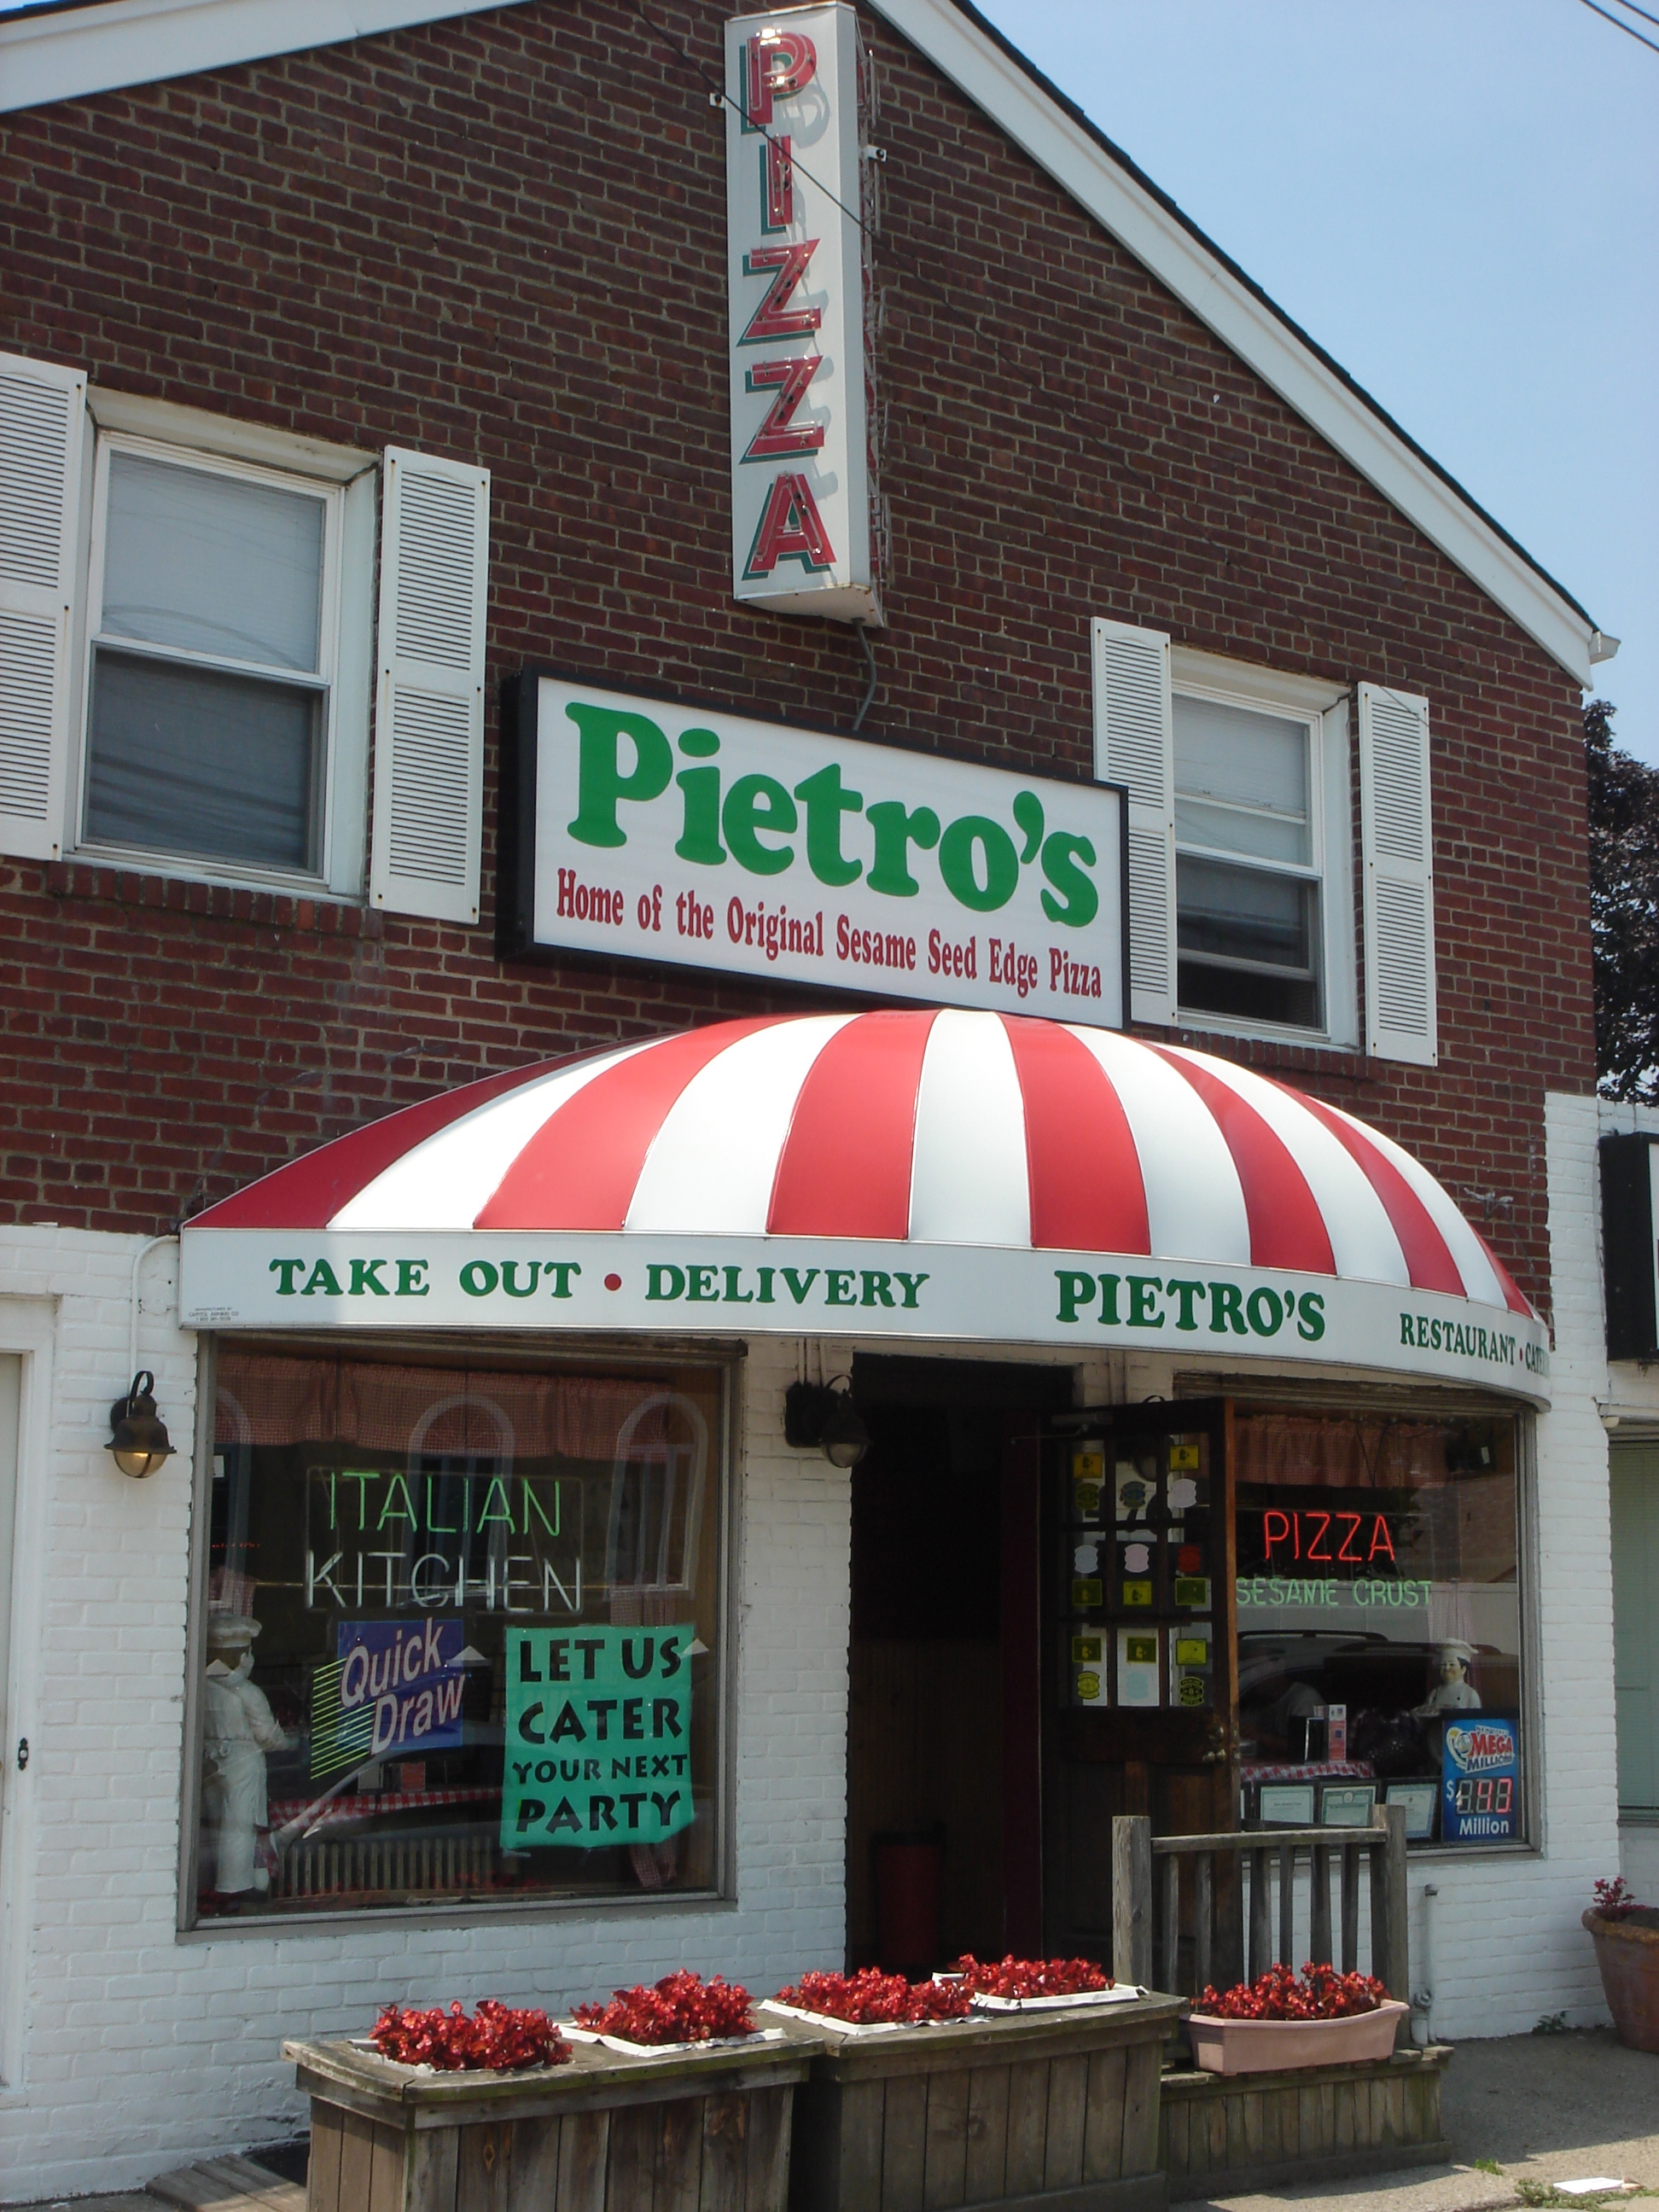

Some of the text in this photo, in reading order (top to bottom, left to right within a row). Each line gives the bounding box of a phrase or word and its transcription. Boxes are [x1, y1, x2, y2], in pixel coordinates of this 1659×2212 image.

[740, 32, 836, 579] PIZZA
[565, 701, 1098, 928] Pietro's
[556, 868, 1102, 998] Home of the Original Sesame Seed Edge Pizza
[268, 1258, 930, 1308] TAKE OUT DELIVERY
[1055, 1271, 1325, 1342] PIETRO'S
[1400, 1313, 1516, 1366] RESTAURANT
[328, 1470, 562, 1536] ITALIAN
[1264, 1511, 1396, 1562] PIZZA
[306, 1549, 581, 1614] KITCHEN
[1236, 1577, 1433, 1607] SESAME CRUST
[341, 1616, 444, 1708] Quick
[519, 1637, 681, 1683] LET US
[370, 1674, 466, 1756] Draw
[517, 1697, 684, 1743] CATER
[512, 1754, 688, 1784] YOUR NEXT
[1468, 1732, 1512, 1757] MEGA
[515, 1790, 682, 1833] PARTY
[1459, 1817, 1510, 1836] Million
